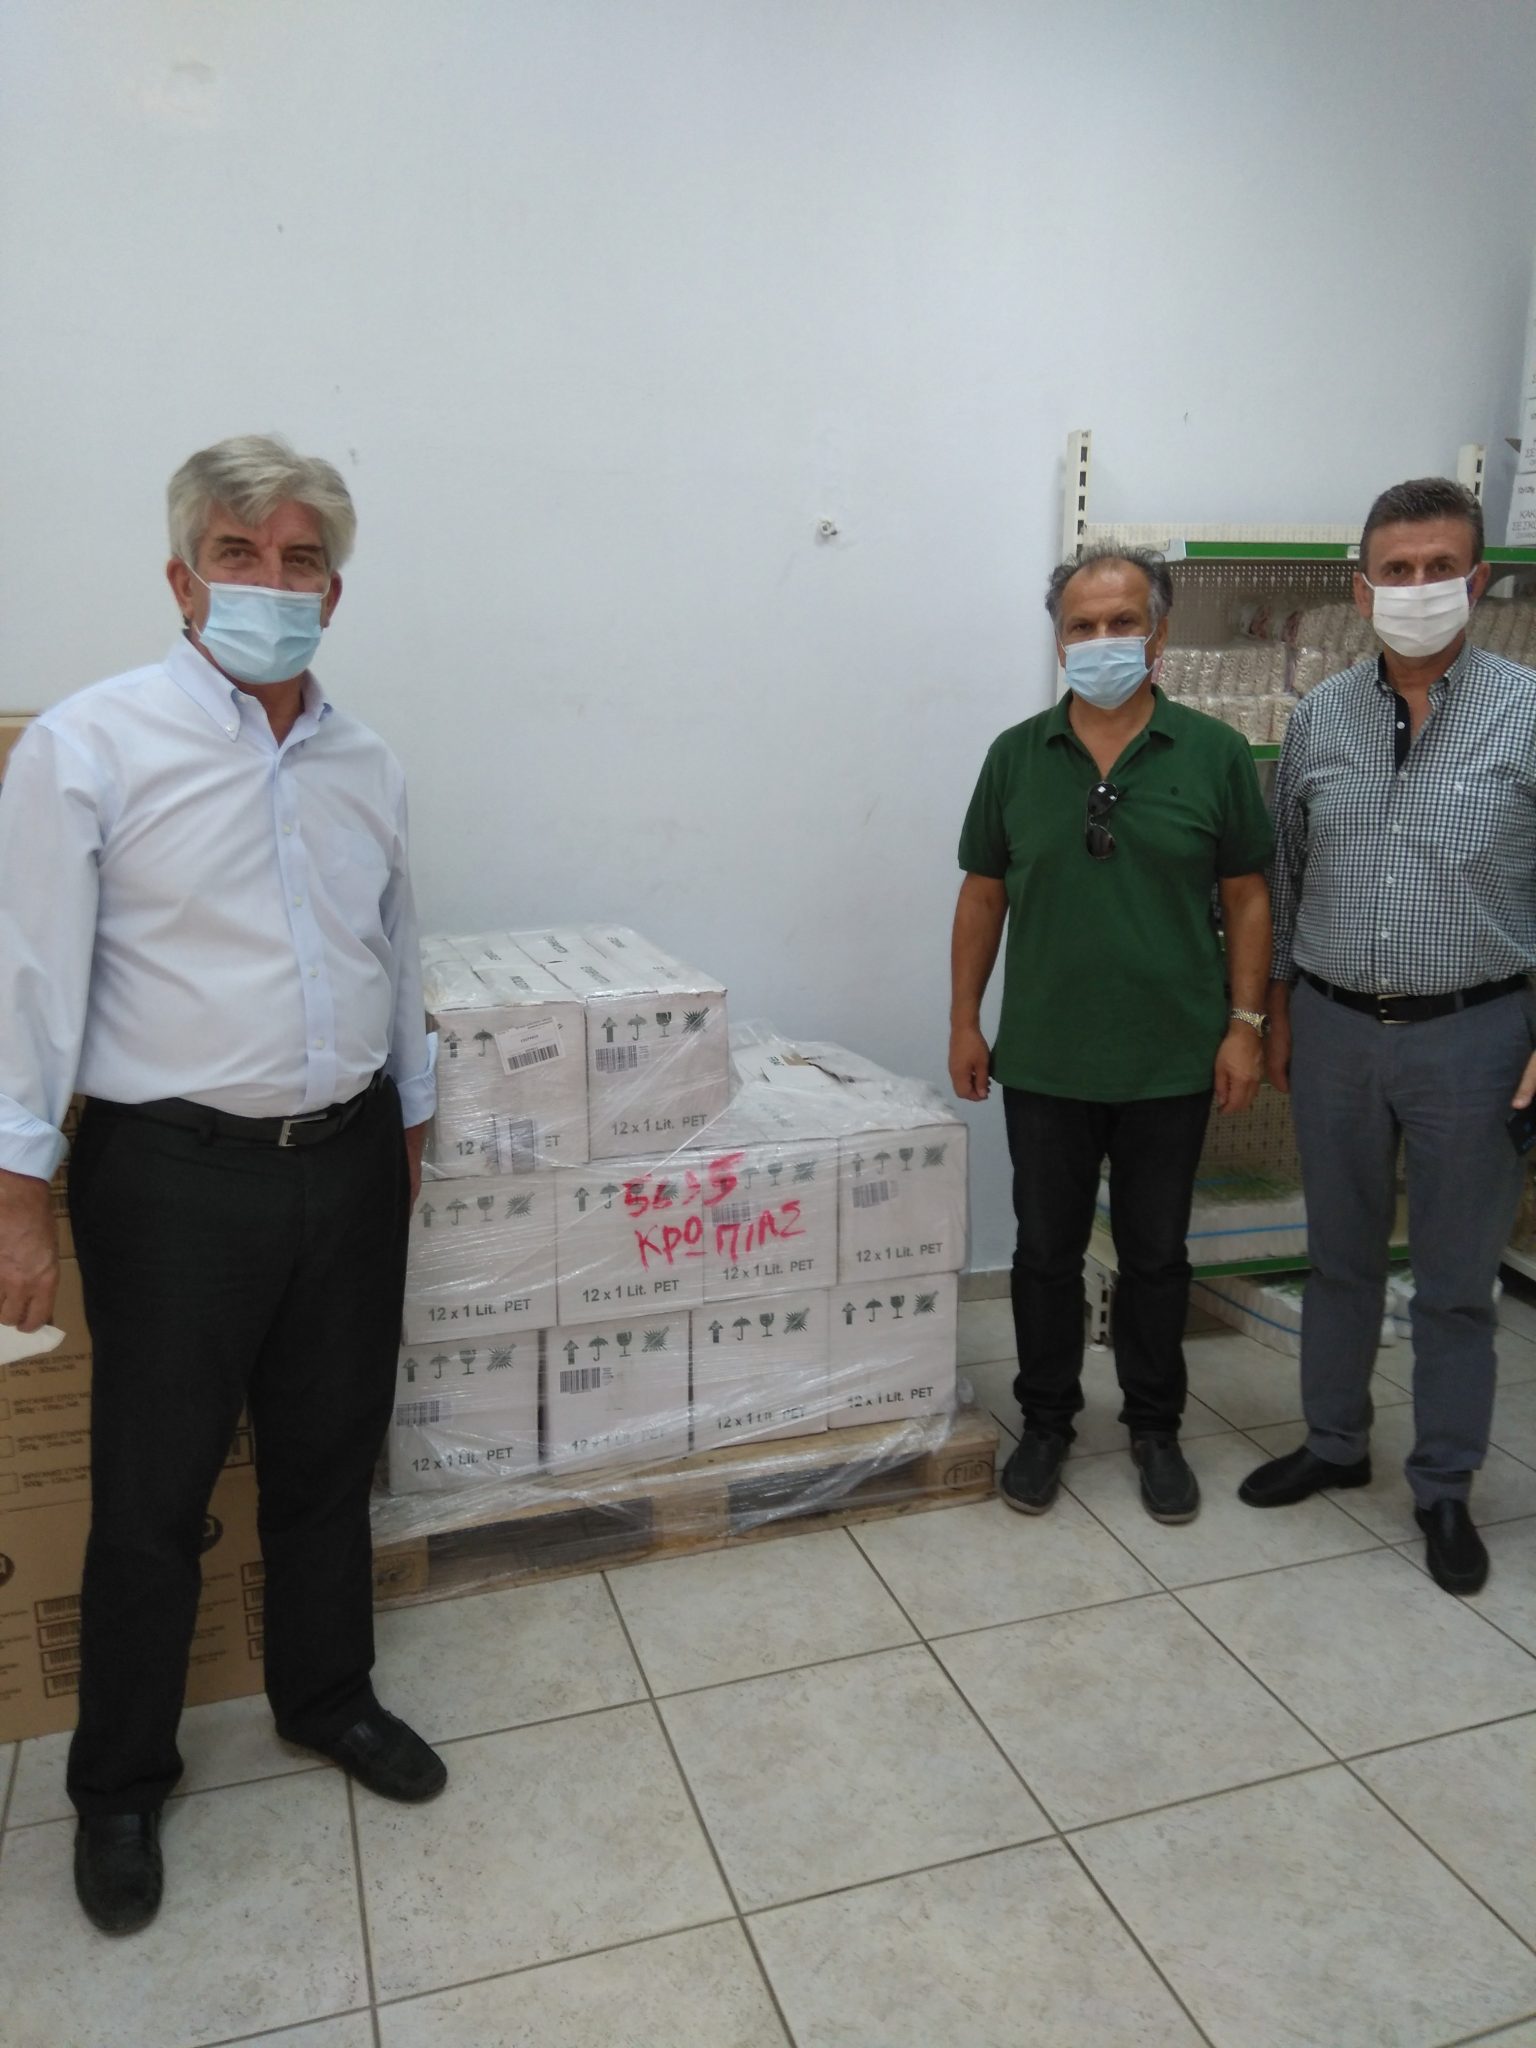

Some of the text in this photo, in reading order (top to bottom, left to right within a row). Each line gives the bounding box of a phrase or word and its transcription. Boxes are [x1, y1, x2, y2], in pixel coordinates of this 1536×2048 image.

[612, 1114, 708, 1136] 12 x 1 Lit. PET
[456, 1141, 474, 1156] 12
[856, 1242, 944, 1263] 12 x 1 Lit. PET
[723, 1258, 815, 1281] 12 x 1 Lit. PET
[582, 1279, 680, 1303] 12 x 1 Lit. PET
[428, 1298, 532, 1322] 12 x 1 Lit. PET
[911, 1386, 934, 1400] PET
[412, 1457, 430, 1473] 12
[434, 1459, 442, 1471] x
[487, 1446, 514, 1462] PET
